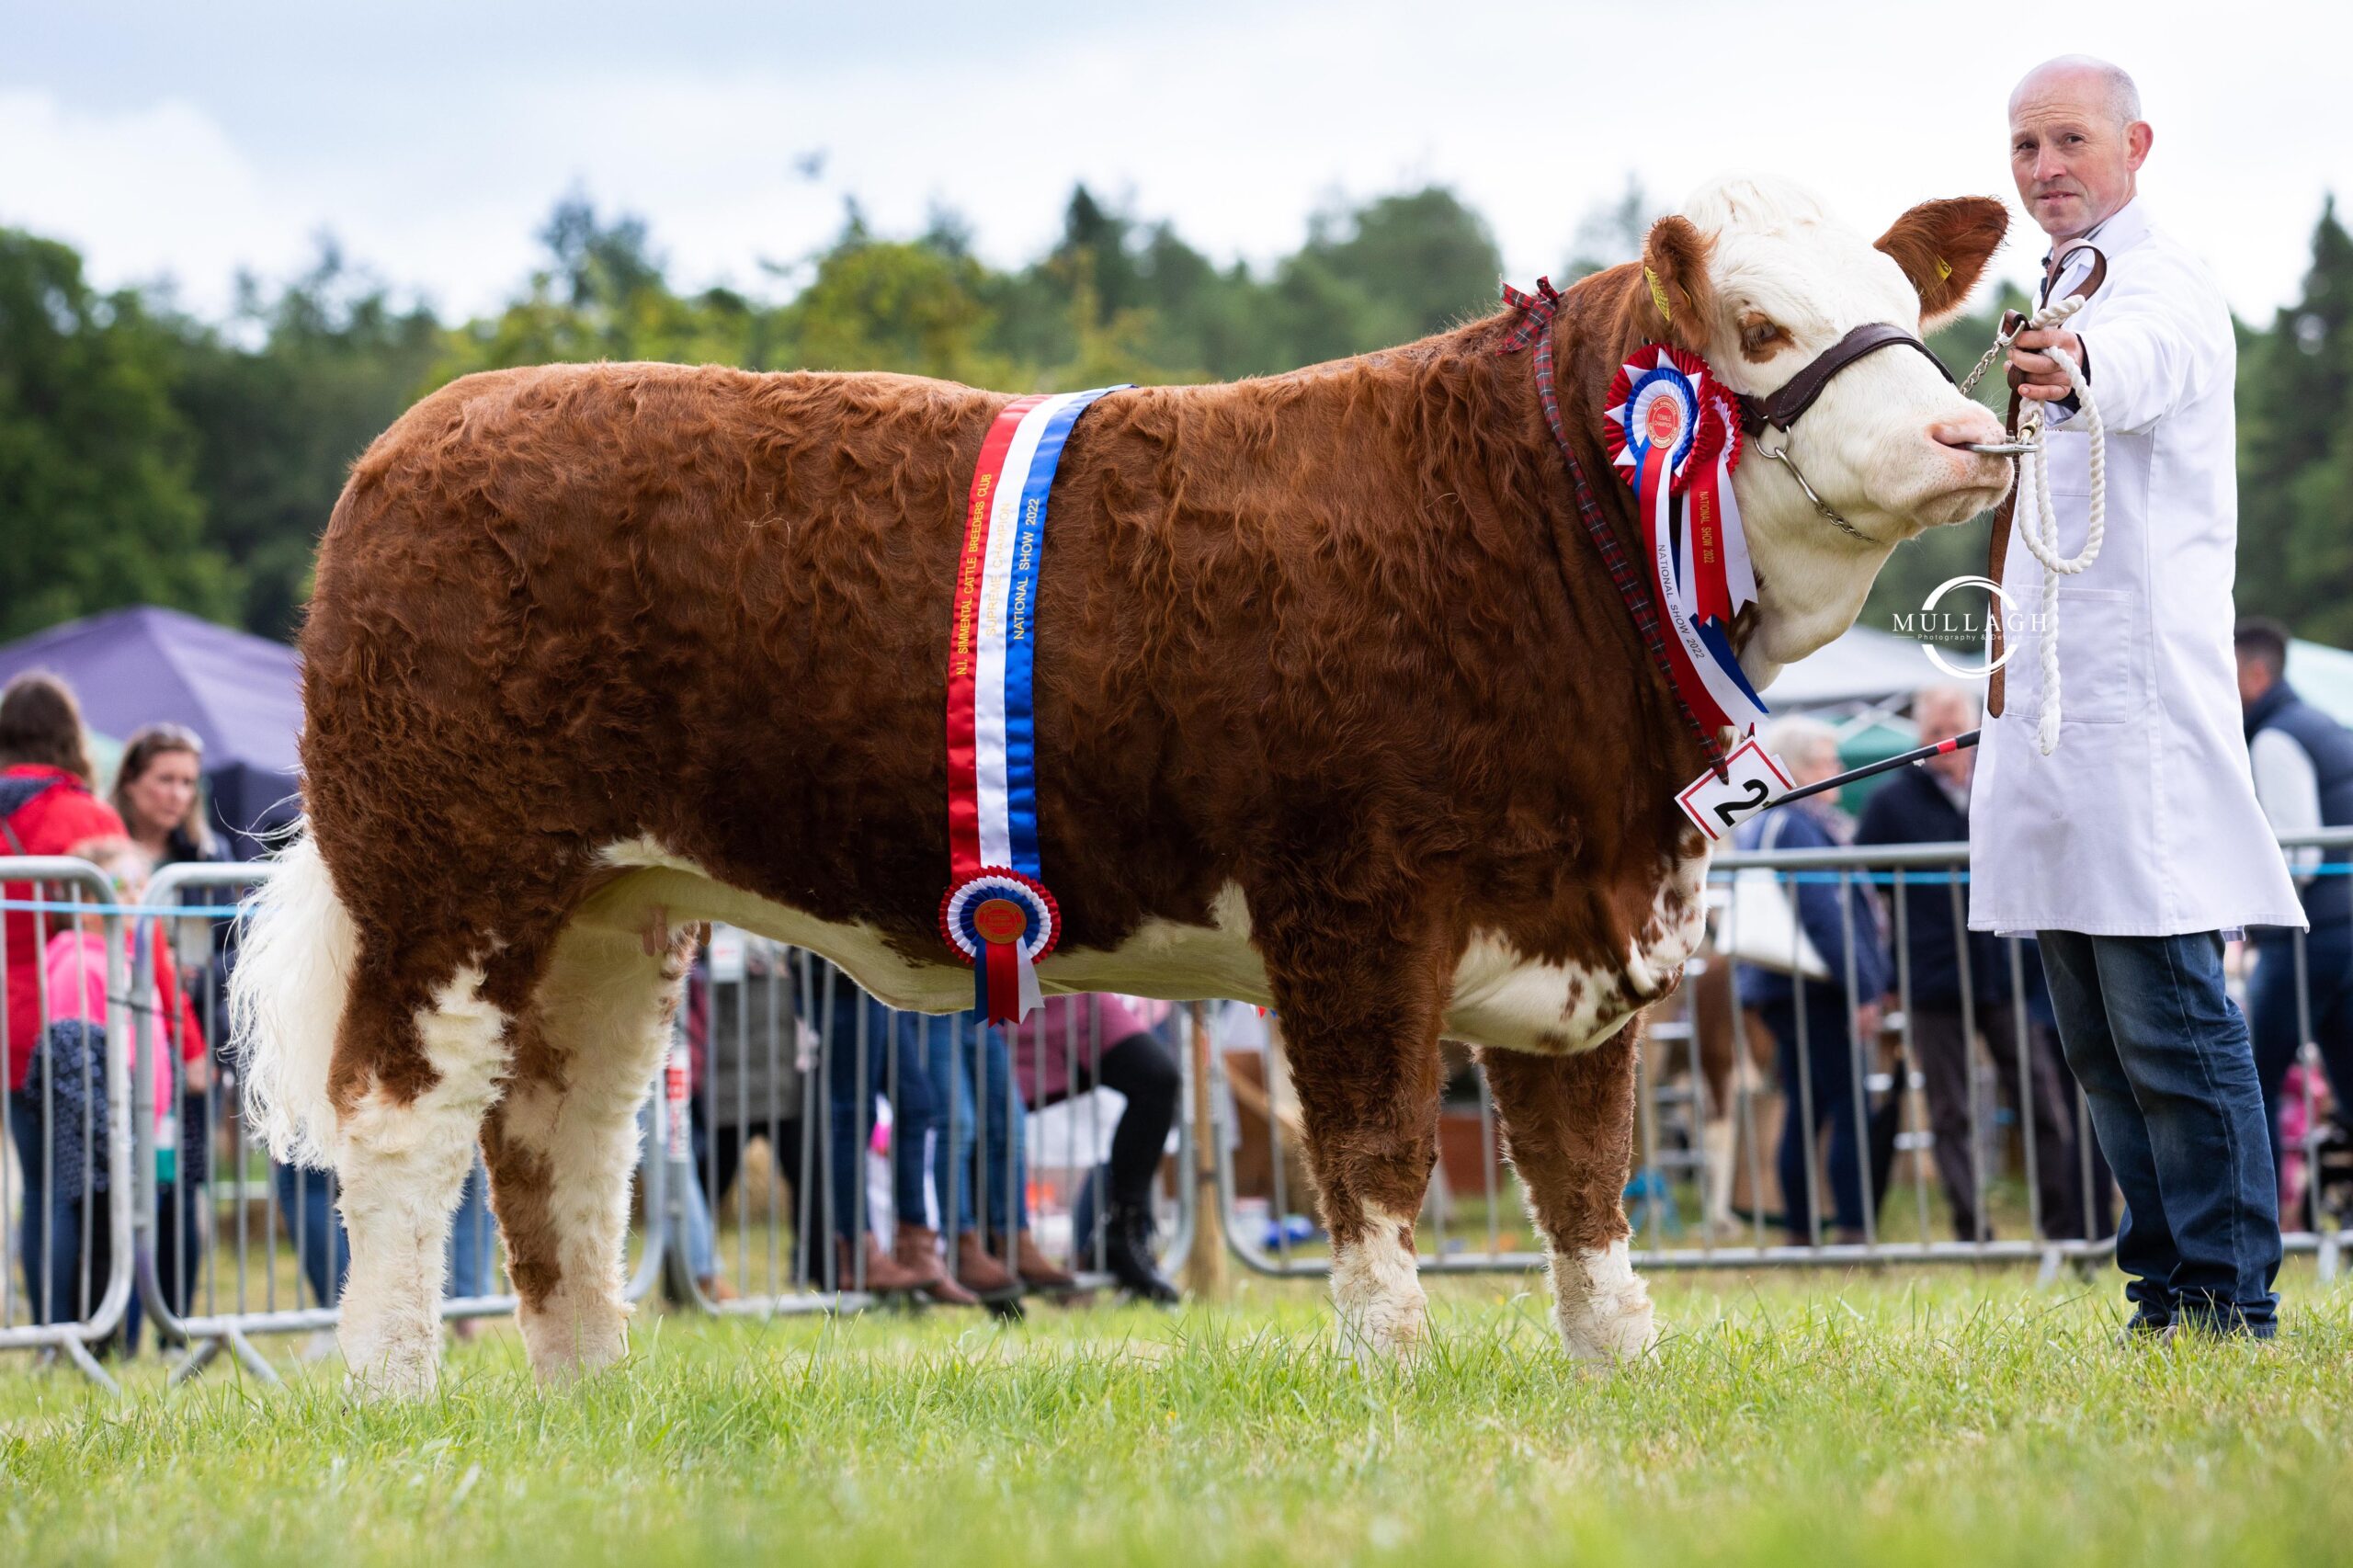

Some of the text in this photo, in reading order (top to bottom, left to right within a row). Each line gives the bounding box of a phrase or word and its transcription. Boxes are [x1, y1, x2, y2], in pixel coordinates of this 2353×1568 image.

[956, 473, 993, 675] N.I. SIMMENTAL CATTLE BREEDERS CLUB
[985, 503, 1010, 637] SUPREME CHAMPION
[1013, 498, 1040, 640] NATIONAL SHOW 2022
[1699, 491, 1715, 564] NATIONAL SHOW 2022
[1657, 544, 1705, 660] NATIONAL SHOW 2022
[1713, 778, 1770, 827] 2
